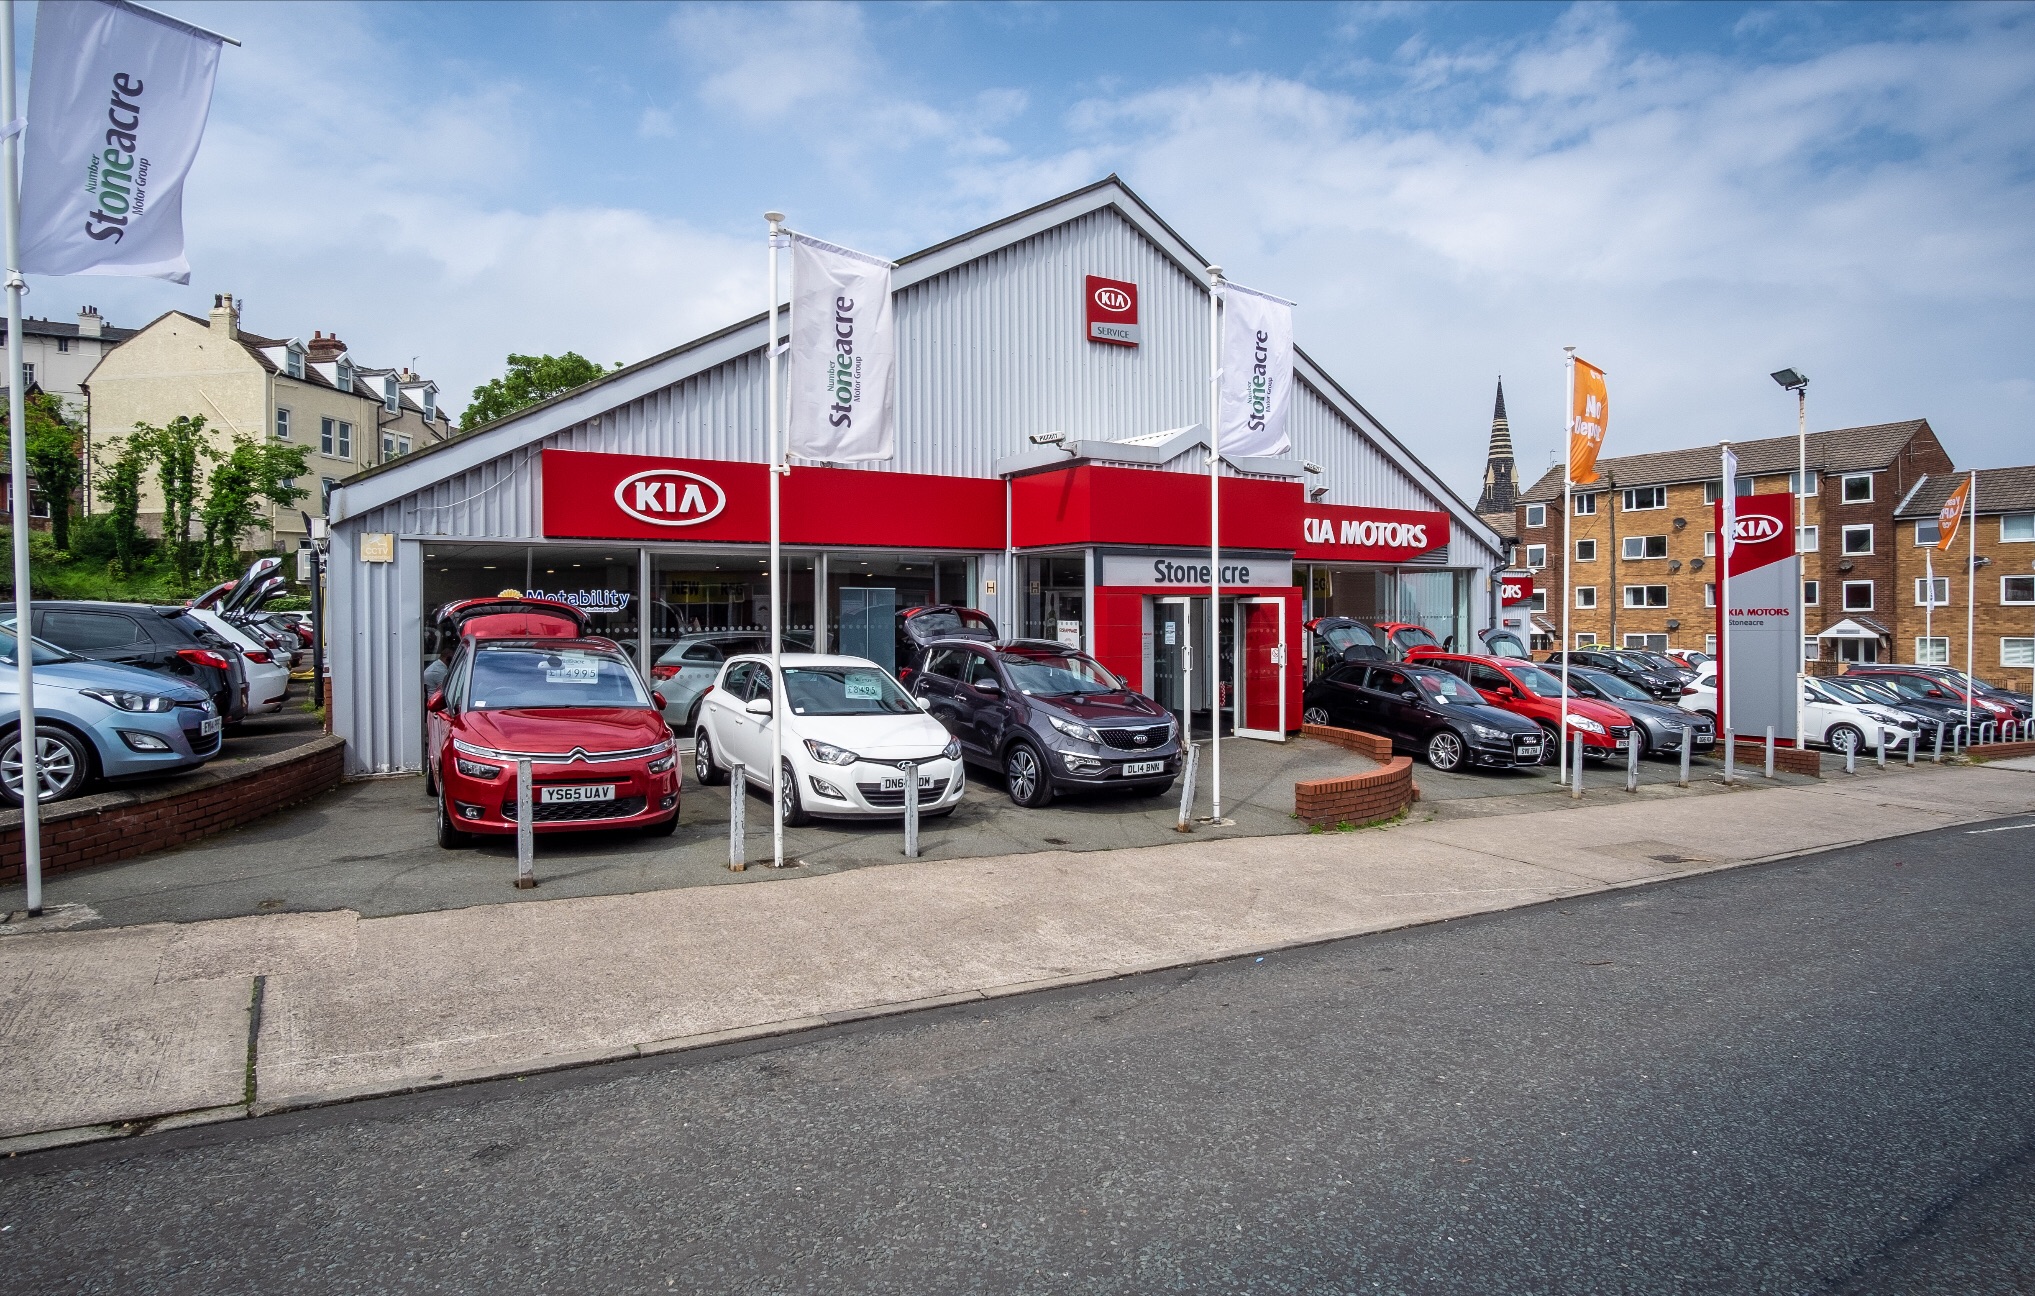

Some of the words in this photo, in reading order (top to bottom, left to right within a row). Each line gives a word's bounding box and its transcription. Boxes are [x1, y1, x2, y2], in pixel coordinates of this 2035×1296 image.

[84, 72, 144, 245] Stoneacre
[85, 153, 100, 194] Number
[135, 157, 151, 187] Group
[132, 187, 146, 216] Motor
[1101, 291, 1125, 308] KIA
[1097, 326, 1130, 339] SERVICE
[828, 296, 855, 429] Stoneacre
[853, 356, 863, 380] Group
[827, 360, 836, 392] Number
[1247, 329, 1268, 432] Stoneacre
[853, 380, 861, 403] Motor
[1585, 393, 1602, 420] No
[635, 481, 707, 513] KIA
[1339, 520, 1428, 548] MOTORS
[1735, 520, 1773, 537] KIA
[365, 547, 389, 555] CCTV
[671, 580, 699, 595] NEW
[986, 581, 995, 593] H
[526, 589, 630, 609] Motability
[1728, 608, 1744, 616] KIA
[1747, 608, 1790, 616] MOTORS
[1127, 764, 1144, 774] DL14
[1146, 762, 1160, 771] BNN
[547, 788, 582, 801] YS65
[585, 787, 610, 799] UAV
[885, 778, 906, 789] DN6
[918, 776, 930, 787] DM
